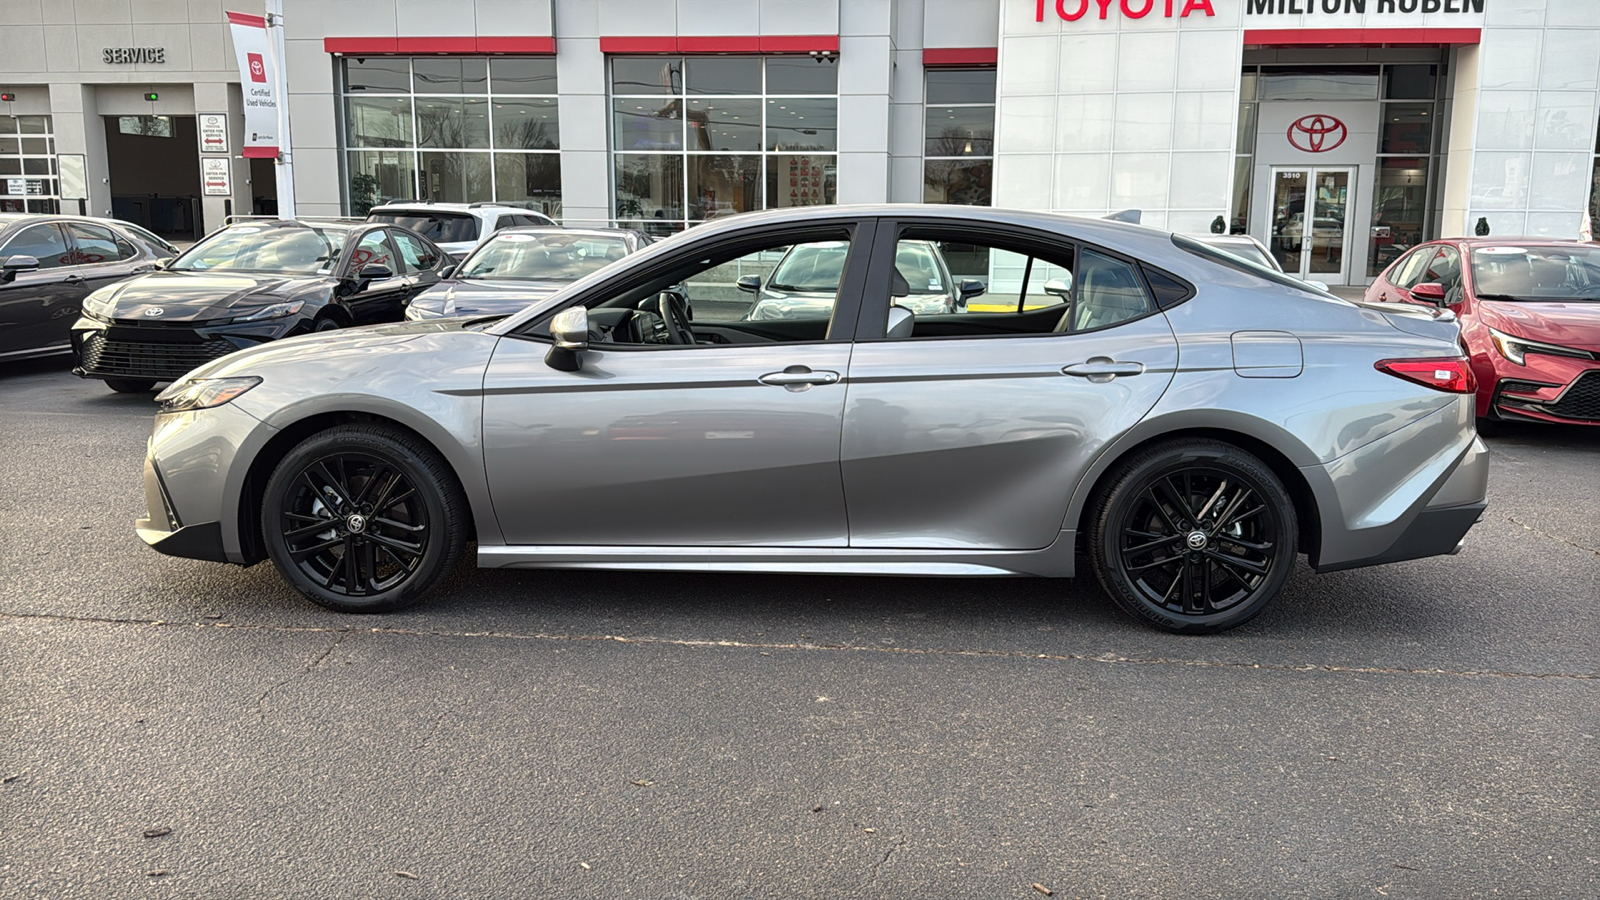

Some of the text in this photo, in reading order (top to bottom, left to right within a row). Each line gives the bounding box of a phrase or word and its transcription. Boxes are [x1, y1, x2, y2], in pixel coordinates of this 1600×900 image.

[102, 47, 165, 64] SERVICE
[250, 88, 271, 97] Certified
[246, 98, 277, 108] Used Vehicles
